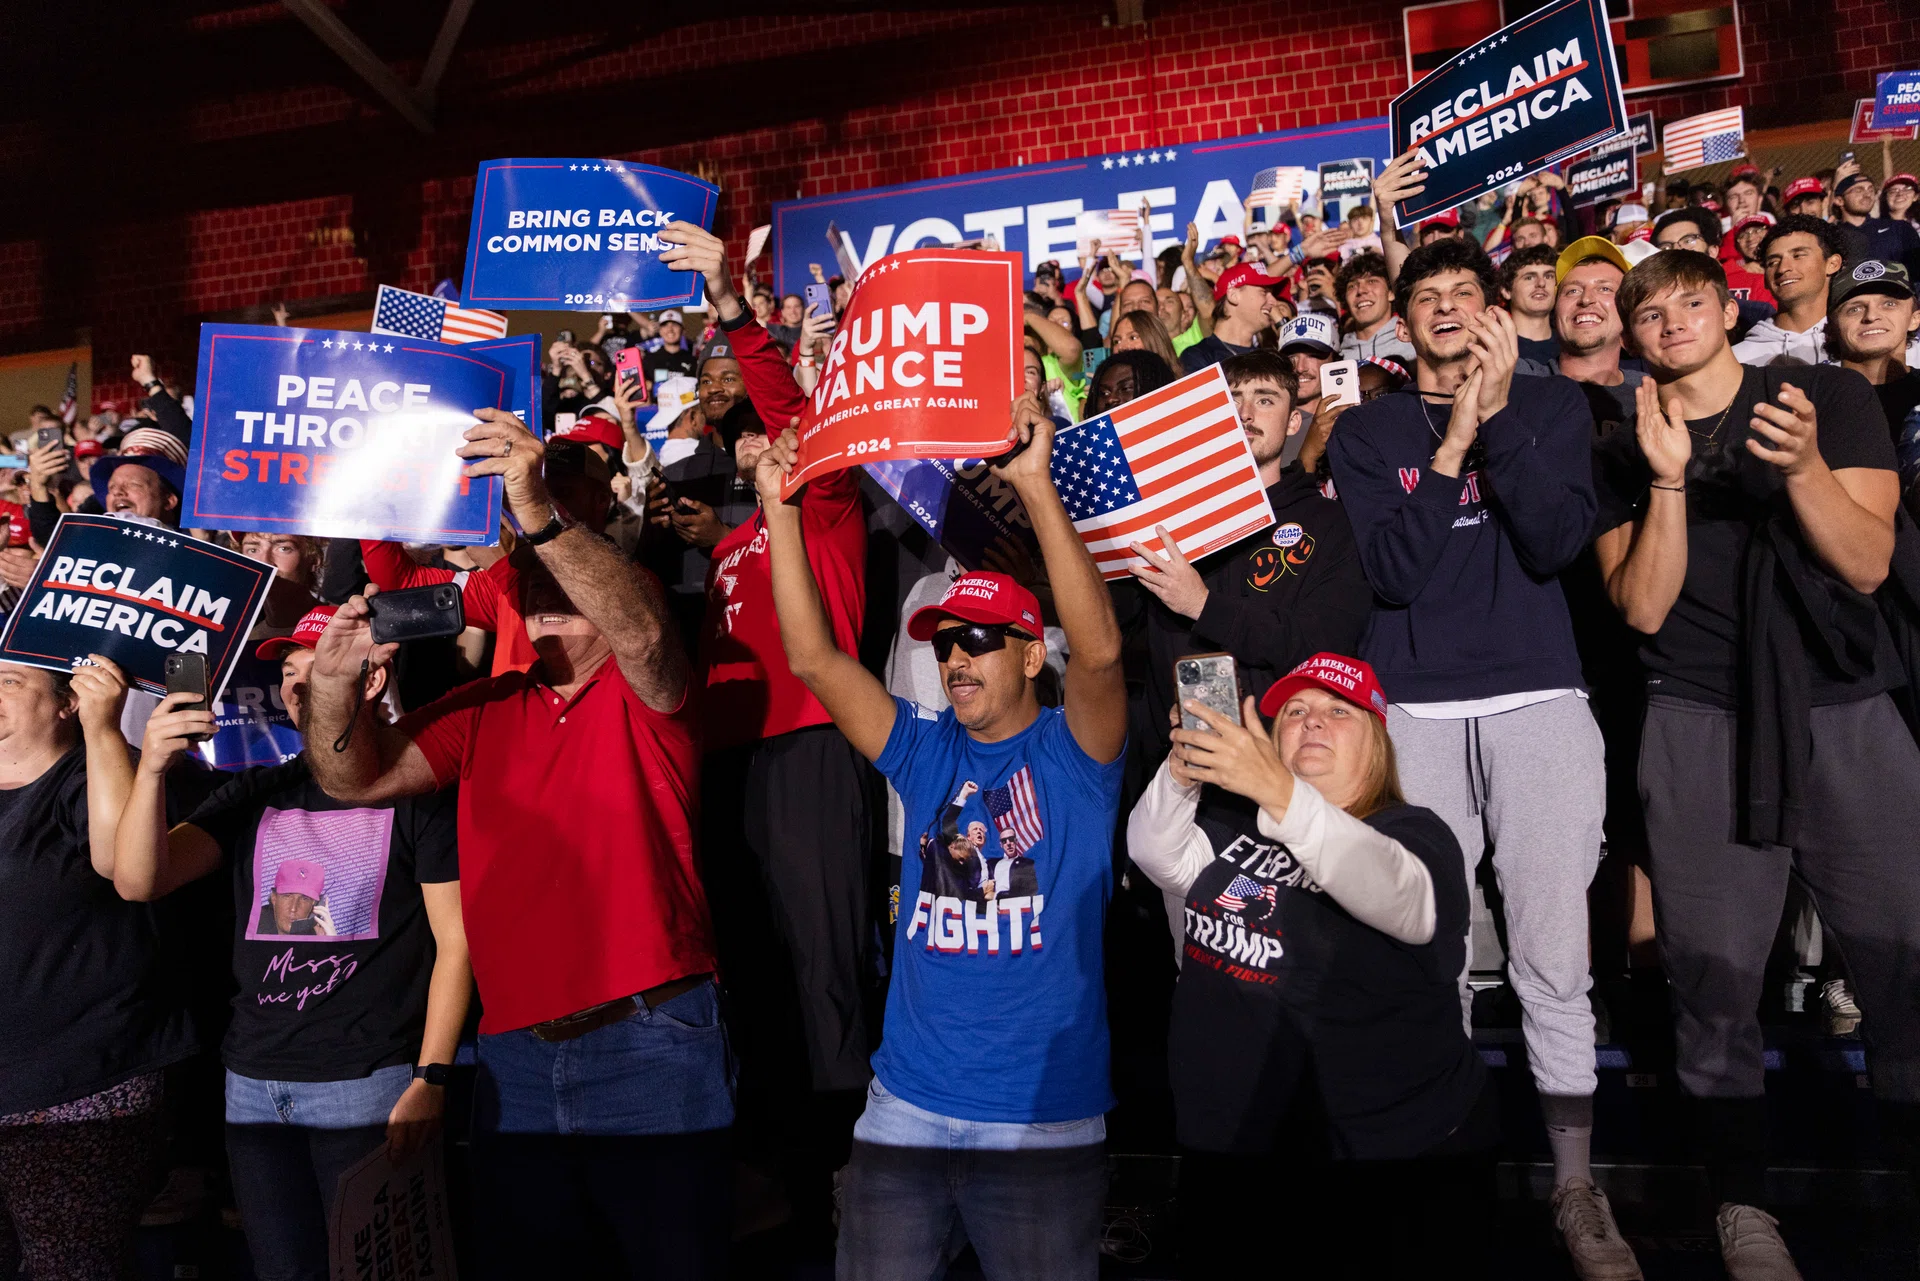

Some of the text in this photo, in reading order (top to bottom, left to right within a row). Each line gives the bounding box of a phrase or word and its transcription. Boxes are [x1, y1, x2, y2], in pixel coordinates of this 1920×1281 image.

[1410, 37, 1583, 145] RECLAIM
[1410, 76, 1593, 177] AMERICA
[1323, 168, 1370, 182] RECLAIM
[1486, 162, 1524, 186] 2024
[1571, 159, 1629, 184] RECLAIM
[1571, 171, 1629, 196] AMERICA
[1323, 178, 1370, 192] AMERICA
[508, 209, 675, 229] BRING BACK
[486, 233, 686, 253] COMMON SENS
[839, 198, 1084, 281] VOTE
[564, 294, 604, 305] 2024
[825, 301, 989, 376] RUMP
[1282, 317, 1326, 338] DETROIT
[277, 374, 432, 412] PEACE
[815, 351, 963, 416] VANCE
[822, 404, 869, 429] AMERICA
[873, 397, 921, 412] GREAT
[926, 397, 979, 409] AGAIN!
[846, 437, 892, 457] 2024
[927, 458, 1012, 538] MERICA GREAT AGAIN!
[909, 500, 938, 529] 2024
[1273, 532, 1303, 540] TRUMP
[48, 555, 231, 625] RECLAIM
[953, 578, 999, 592] AMERICA
[959, 587, 994, 600] AGAIN
[30, 591, 208, 653] AMERICA
[1309, 658, 1363, 682] AMERICA
[1316, 669, 1356, 691] AGAIN
[215, 718, 245, 727] MAKE
[279, 753, 297, 763] 20
[906, 890, 1044, 957] FIGHT!
[1223, 912, 1246, 928] FOR
[1185, 907, 1284, 969] TRUMP
[262, 947, 354, 984] Miss
[257, 961, 358, 1012] me yet?
